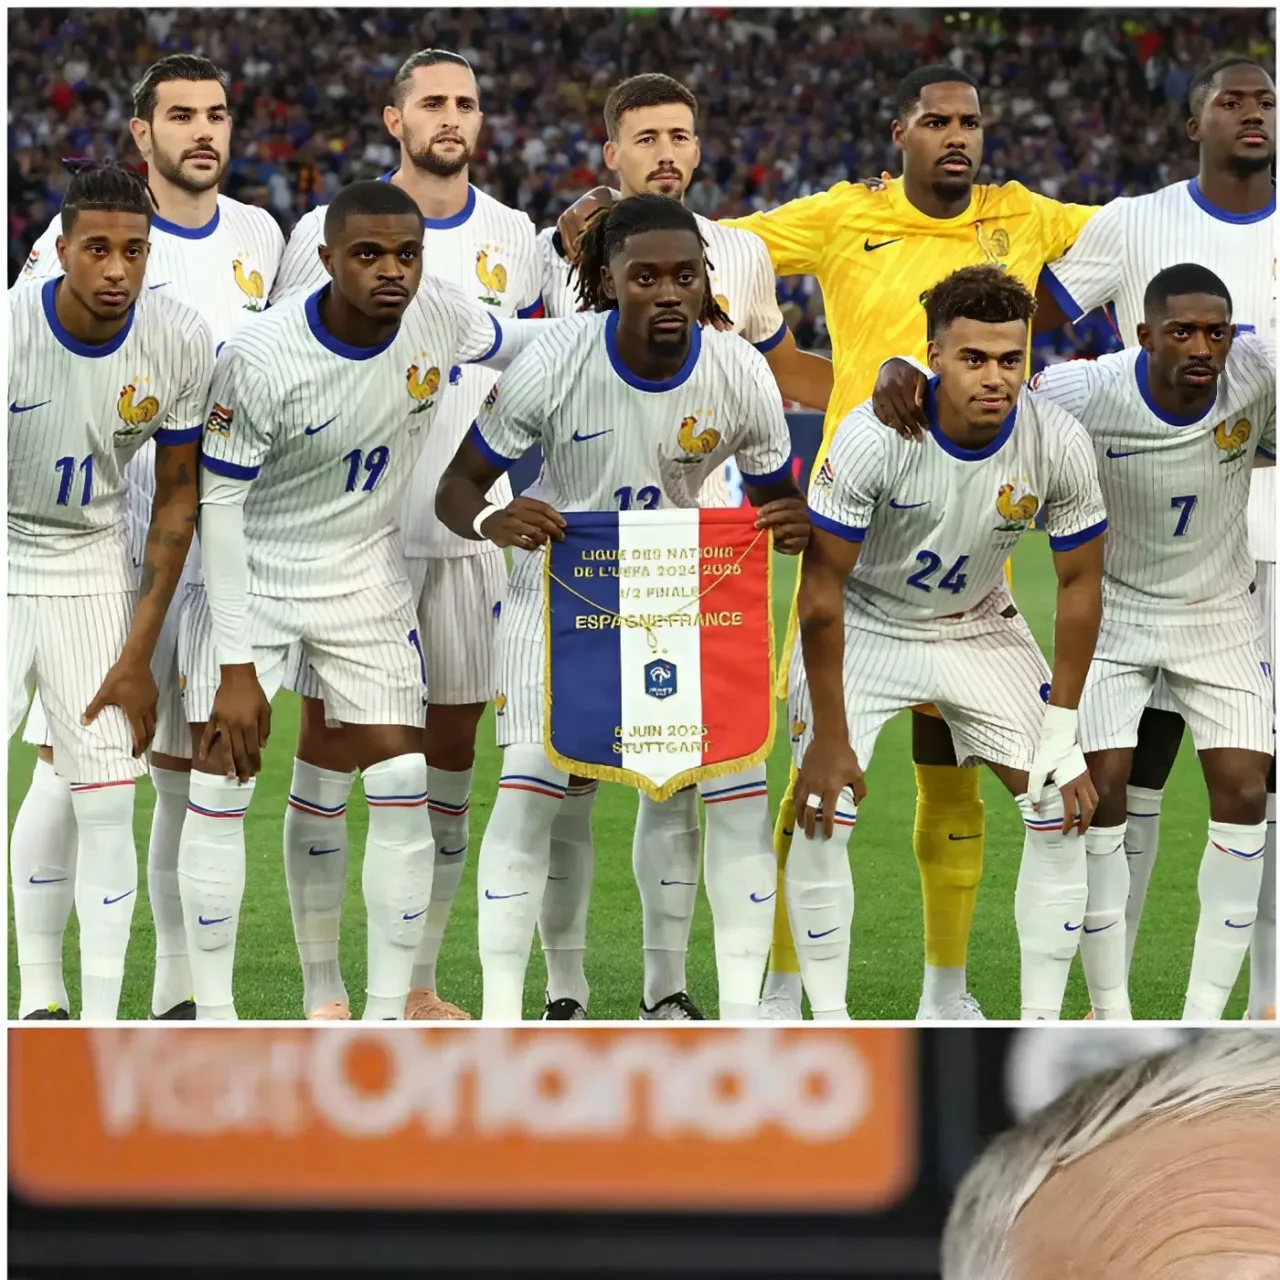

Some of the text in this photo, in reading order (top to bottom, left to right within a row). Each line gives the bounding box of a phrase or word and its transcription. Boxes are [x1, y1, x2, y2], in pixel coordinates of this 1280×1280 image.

[55, 456, 94, 506] 11
[343, 445, 389, 492] 19
[1170, 495, 1198, 537] 7
[906, 550, 969, 594] 24
